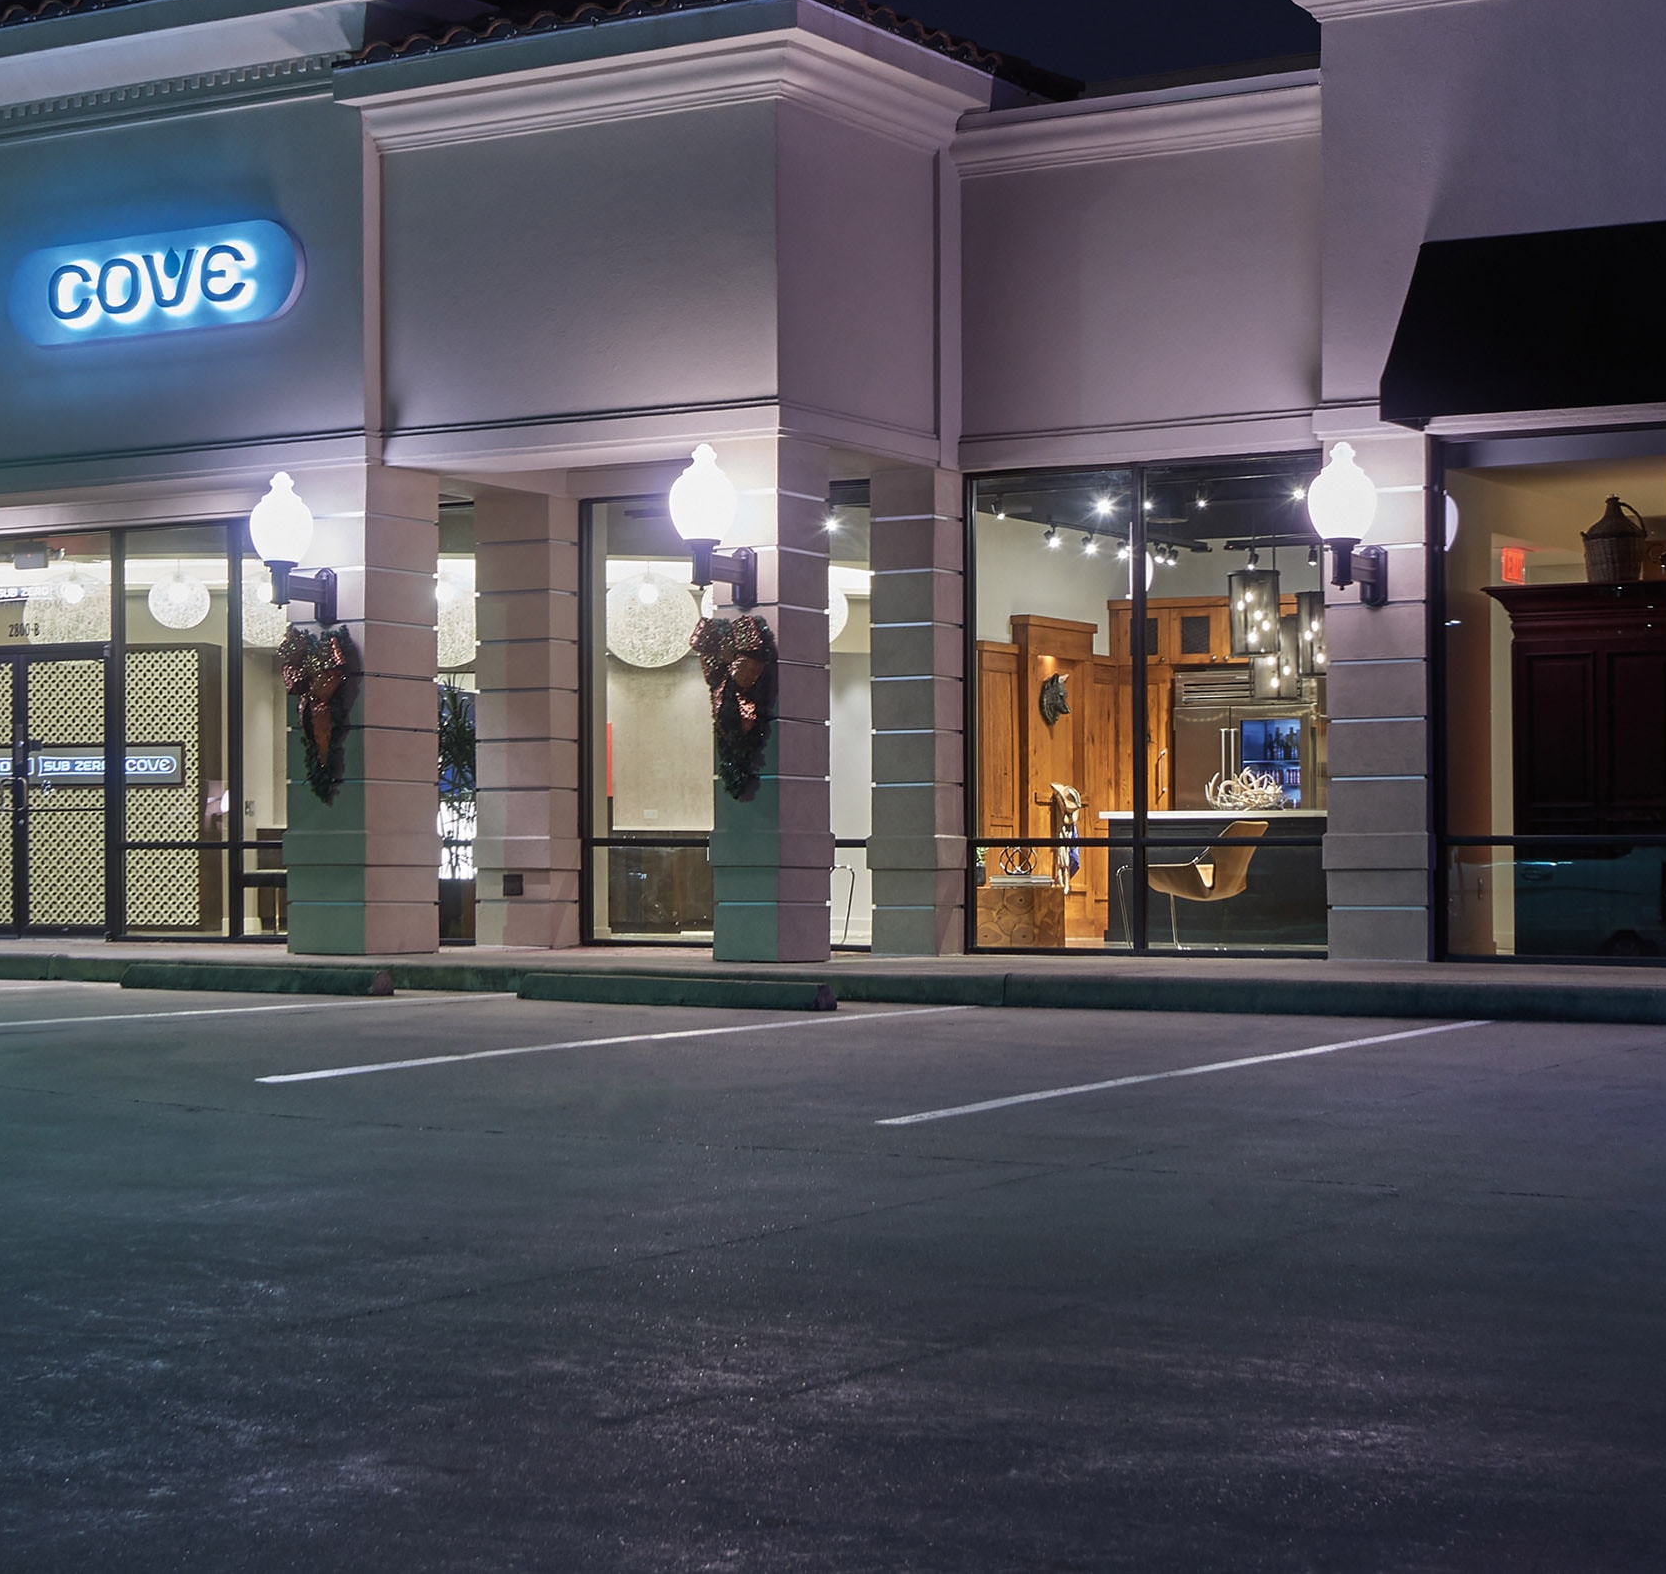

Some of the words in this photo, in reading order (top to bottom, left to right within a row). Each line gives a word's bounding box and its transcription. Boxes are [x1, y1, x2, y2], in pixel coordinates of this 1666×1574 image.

[47, 241, 251, 324] COVE
[8, 622, 40, 638] 2800-B
[43, 761, 72, 772] SUB
[125, 759, 171, 772] COVE
